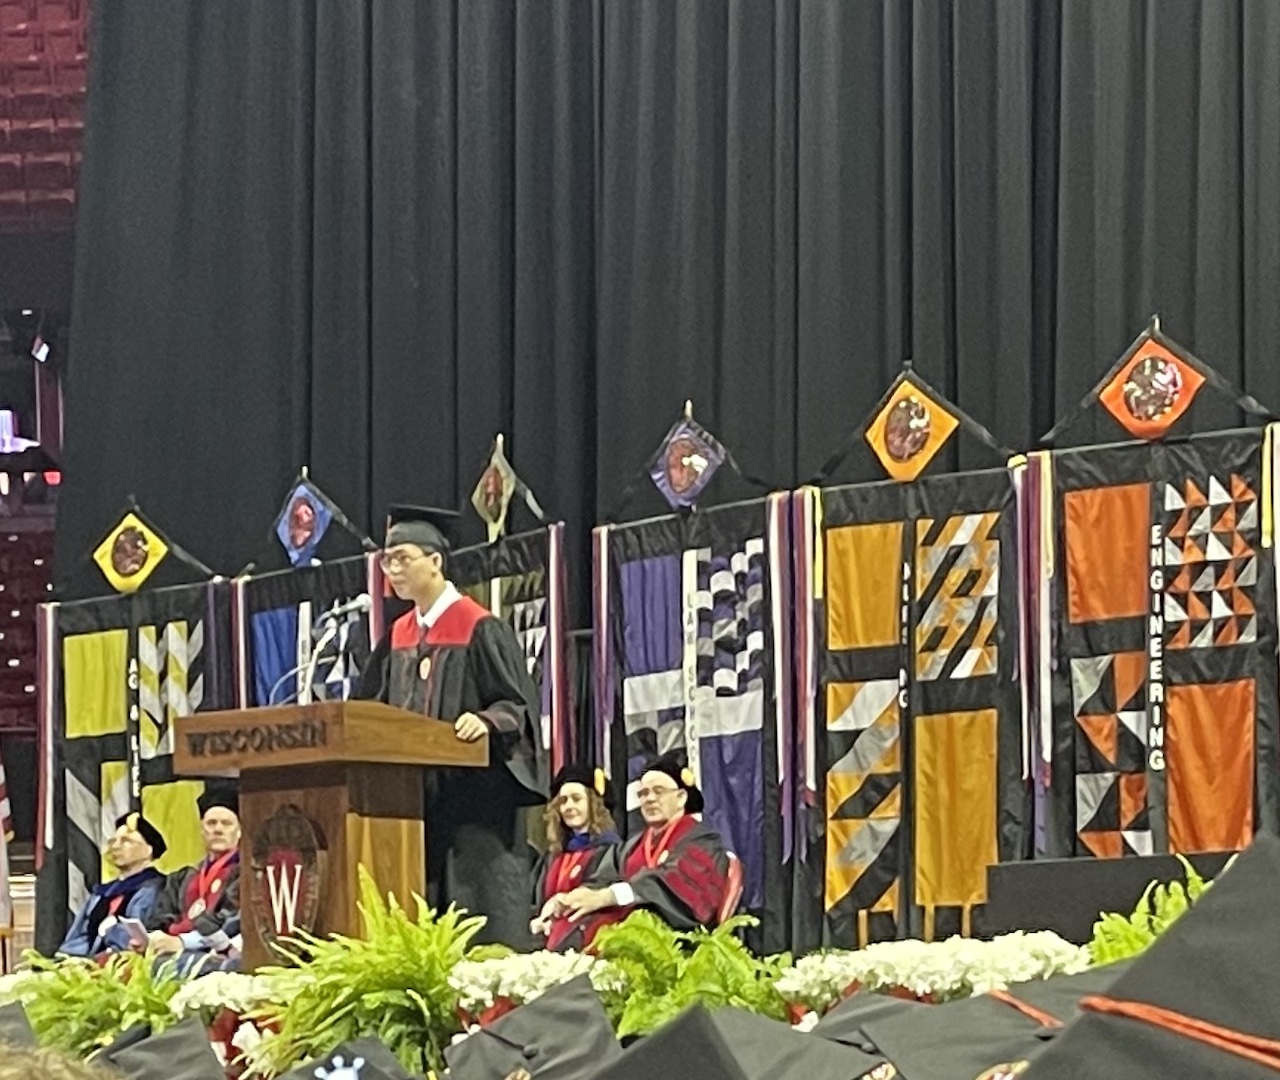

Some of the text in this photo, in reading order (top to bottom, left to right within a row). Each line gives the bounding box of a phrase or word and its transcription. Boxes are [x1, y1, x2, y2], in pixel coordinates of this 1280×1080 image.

[1148, 524, 1165, 771] ENGINEERING
[185, 719, 327, 758] WISCONSIN
[266, 860, 303, 934] W
